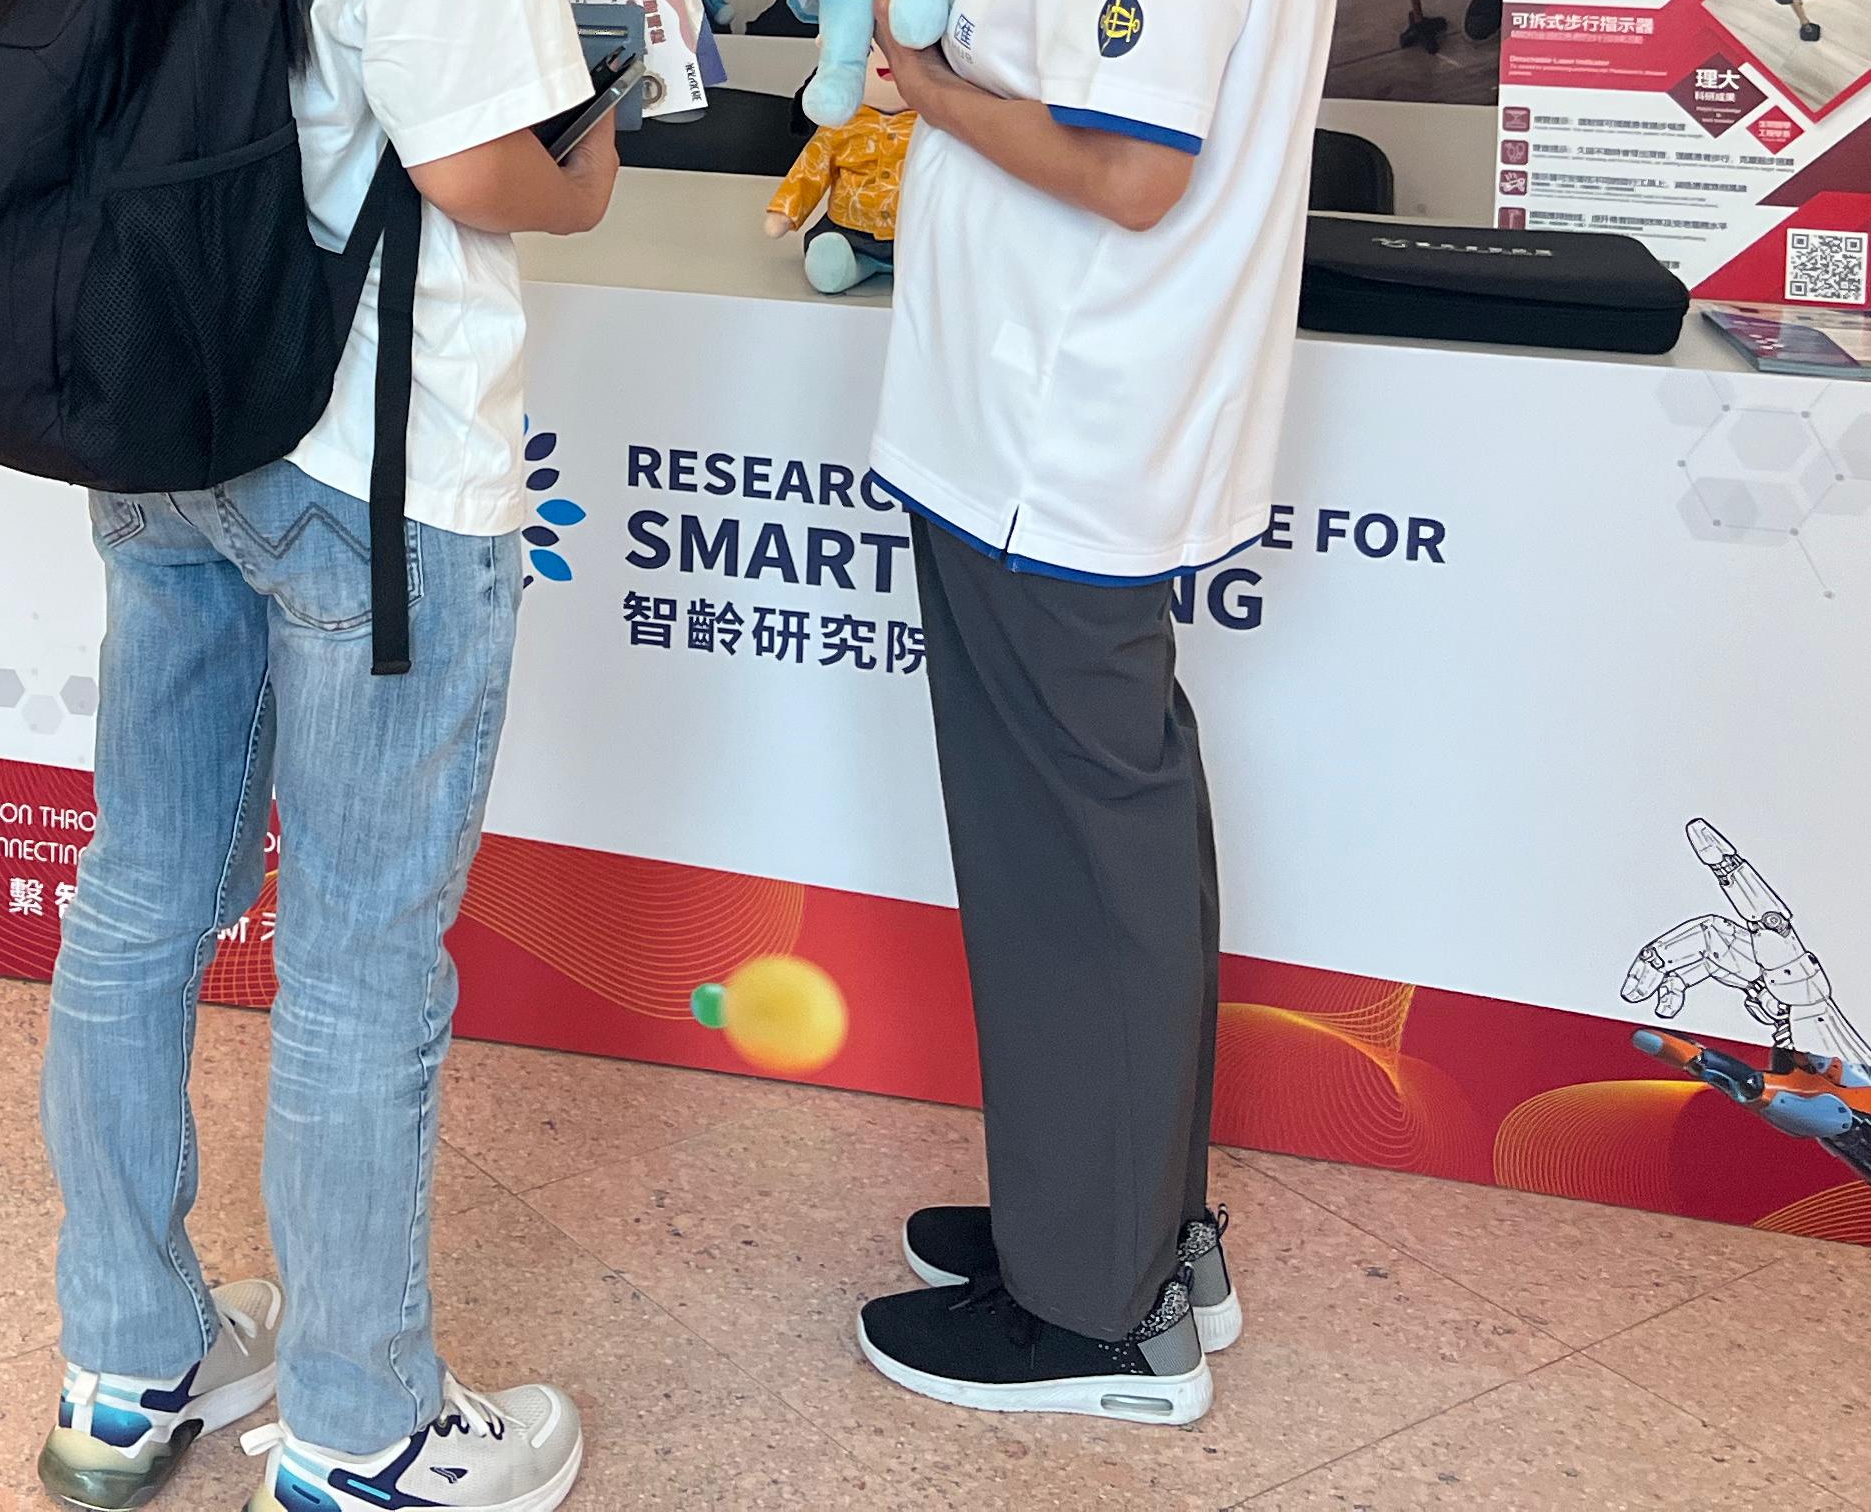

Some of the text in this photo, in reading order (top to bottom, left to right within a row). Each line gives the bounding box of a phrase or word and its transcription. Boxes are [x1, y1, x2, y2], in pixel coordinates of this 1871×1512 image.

[1695, 69, 1740, 90] 理大
[628, 445, 909, 512] RESEARC
[1316, 508, 1445, 564] FOR
[625, 510, 910, 593] SMART
